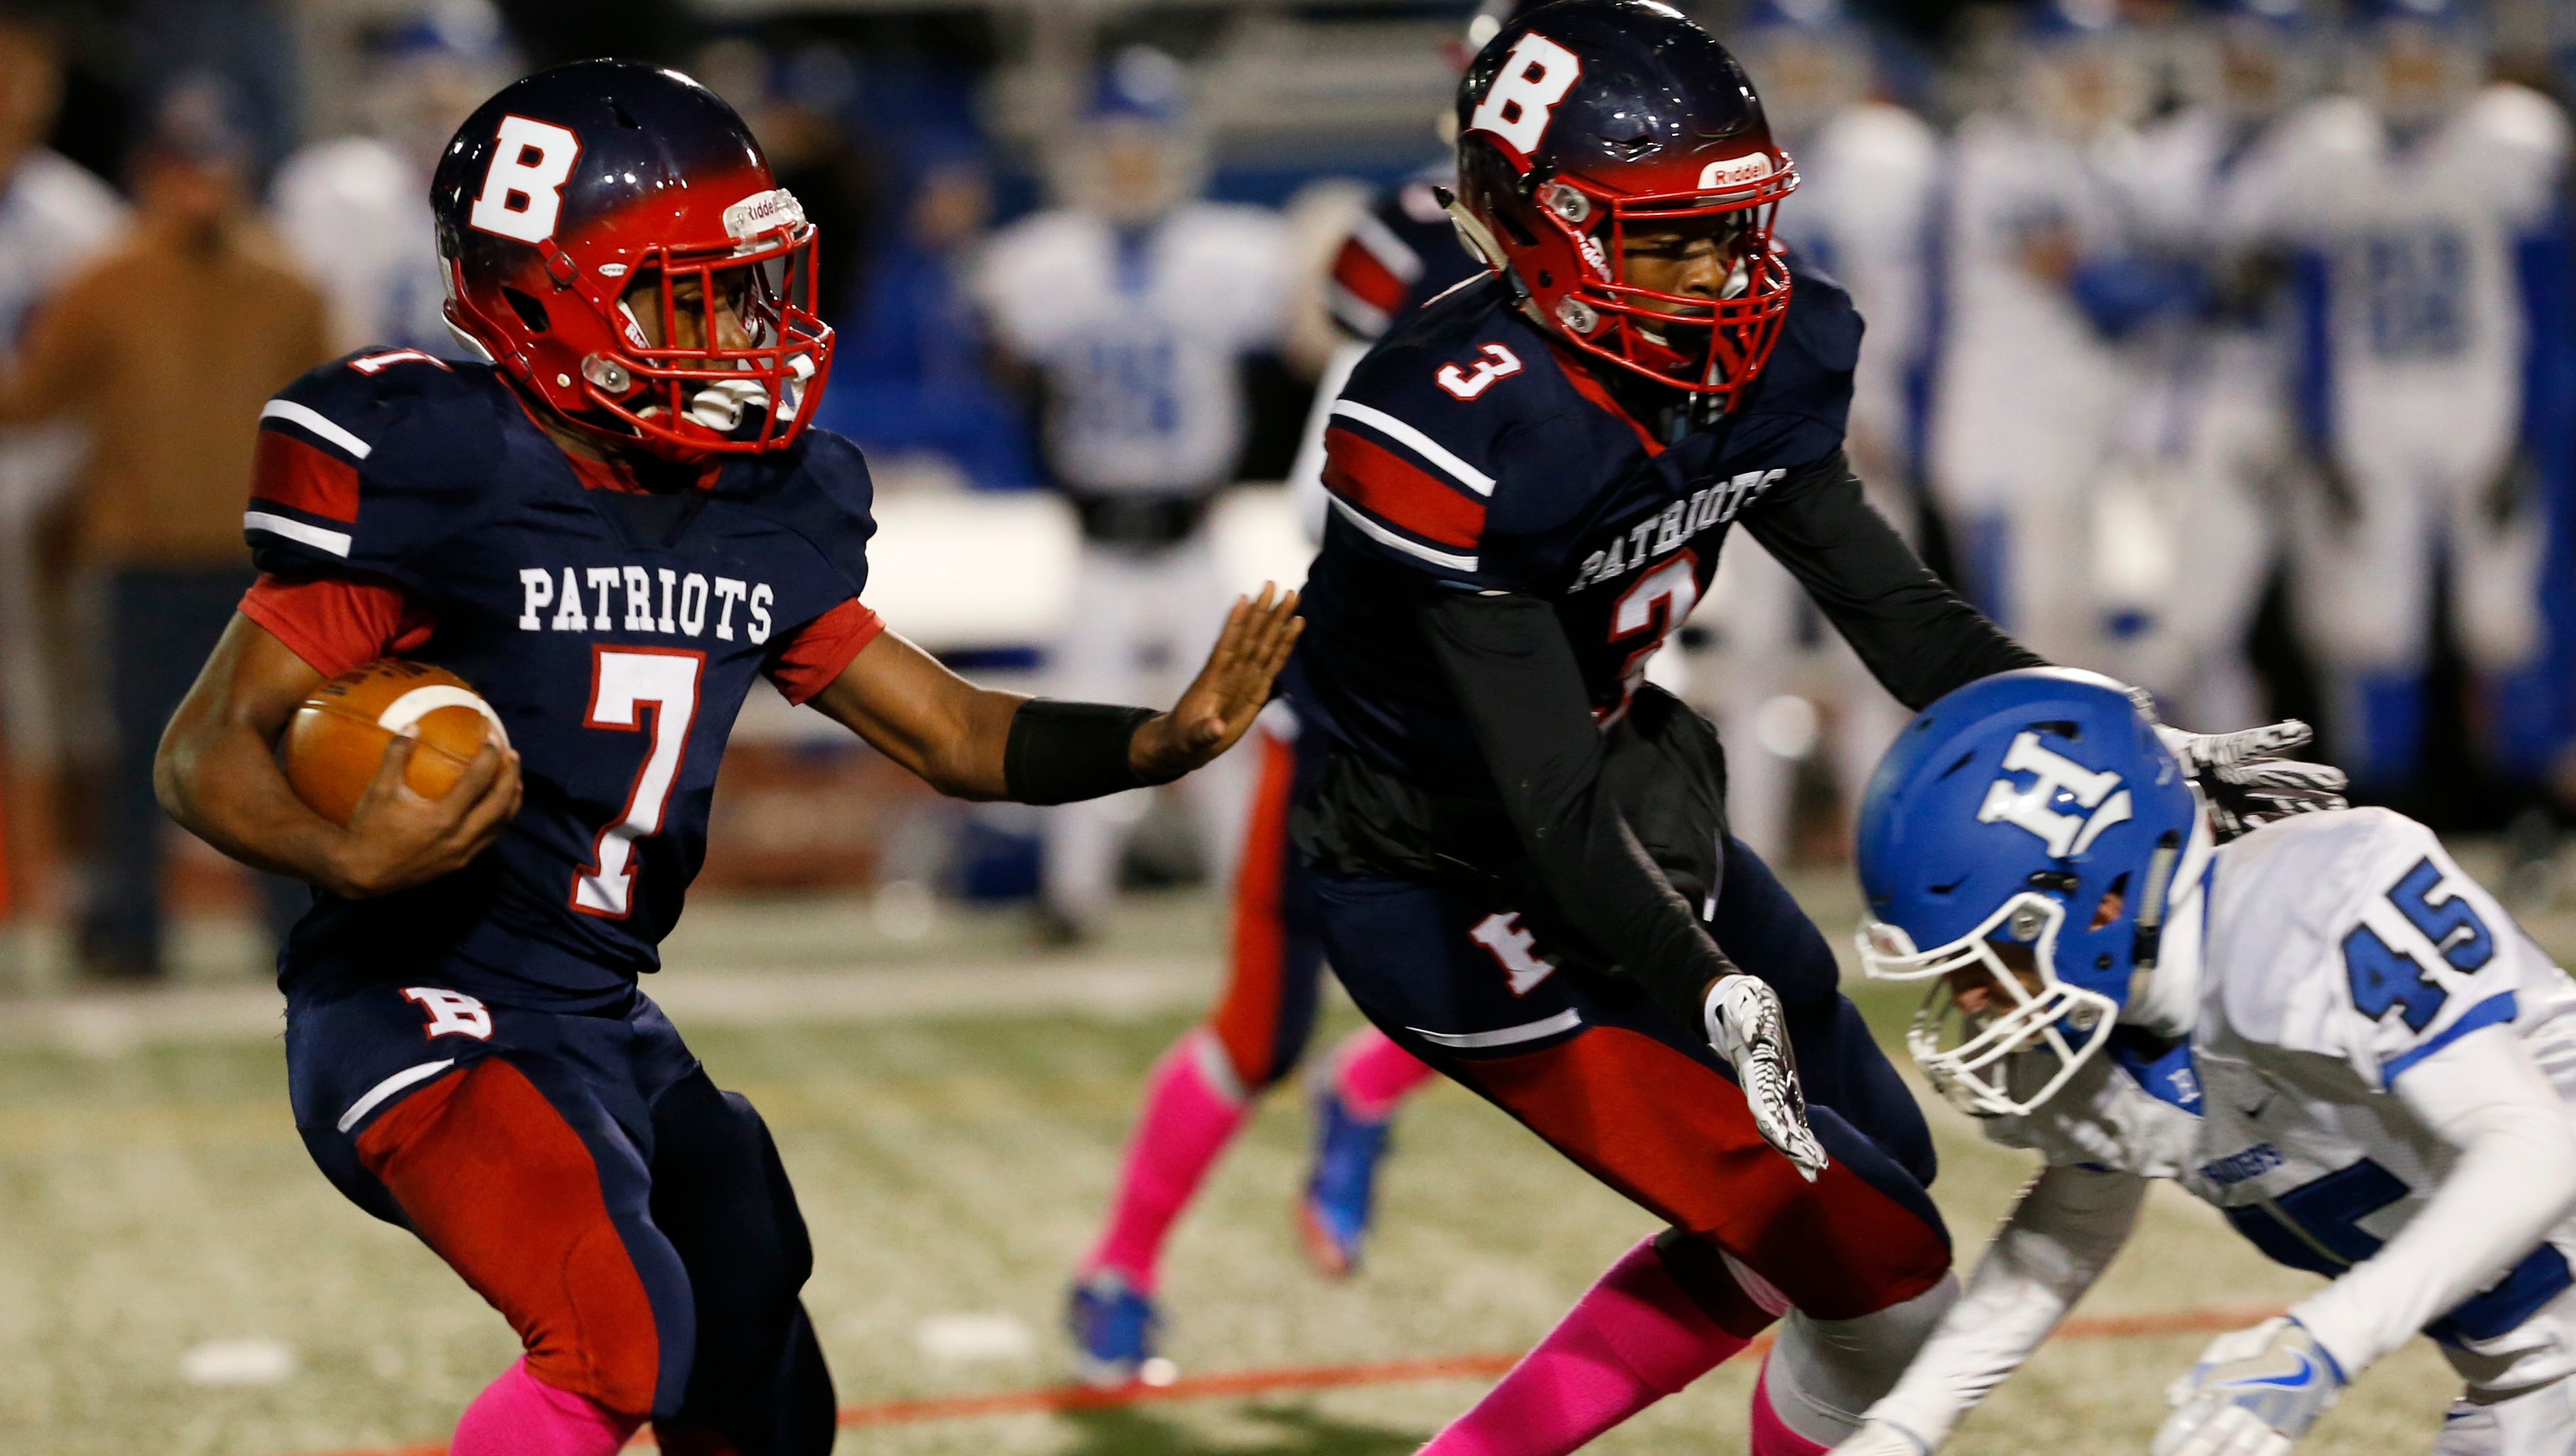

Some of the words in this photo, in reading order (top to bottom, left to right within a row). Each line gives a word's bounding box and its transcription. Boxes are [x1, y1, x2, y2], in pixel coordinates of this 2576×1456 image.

[1471, 29, 1582, 157] B
[469, 112, 583, 244] B
[1436, 342, 1524, 401] 3
[1566, 468, 1787, 594] PATRIOTS
[519, 566, 775, 645] PATRIOTS
[568, 643, 707, 920] 7
[1977, 730, 2133, 858] H
[2340, 855, 2495, 1031] 45
[399, 986, 495, 1041] B
